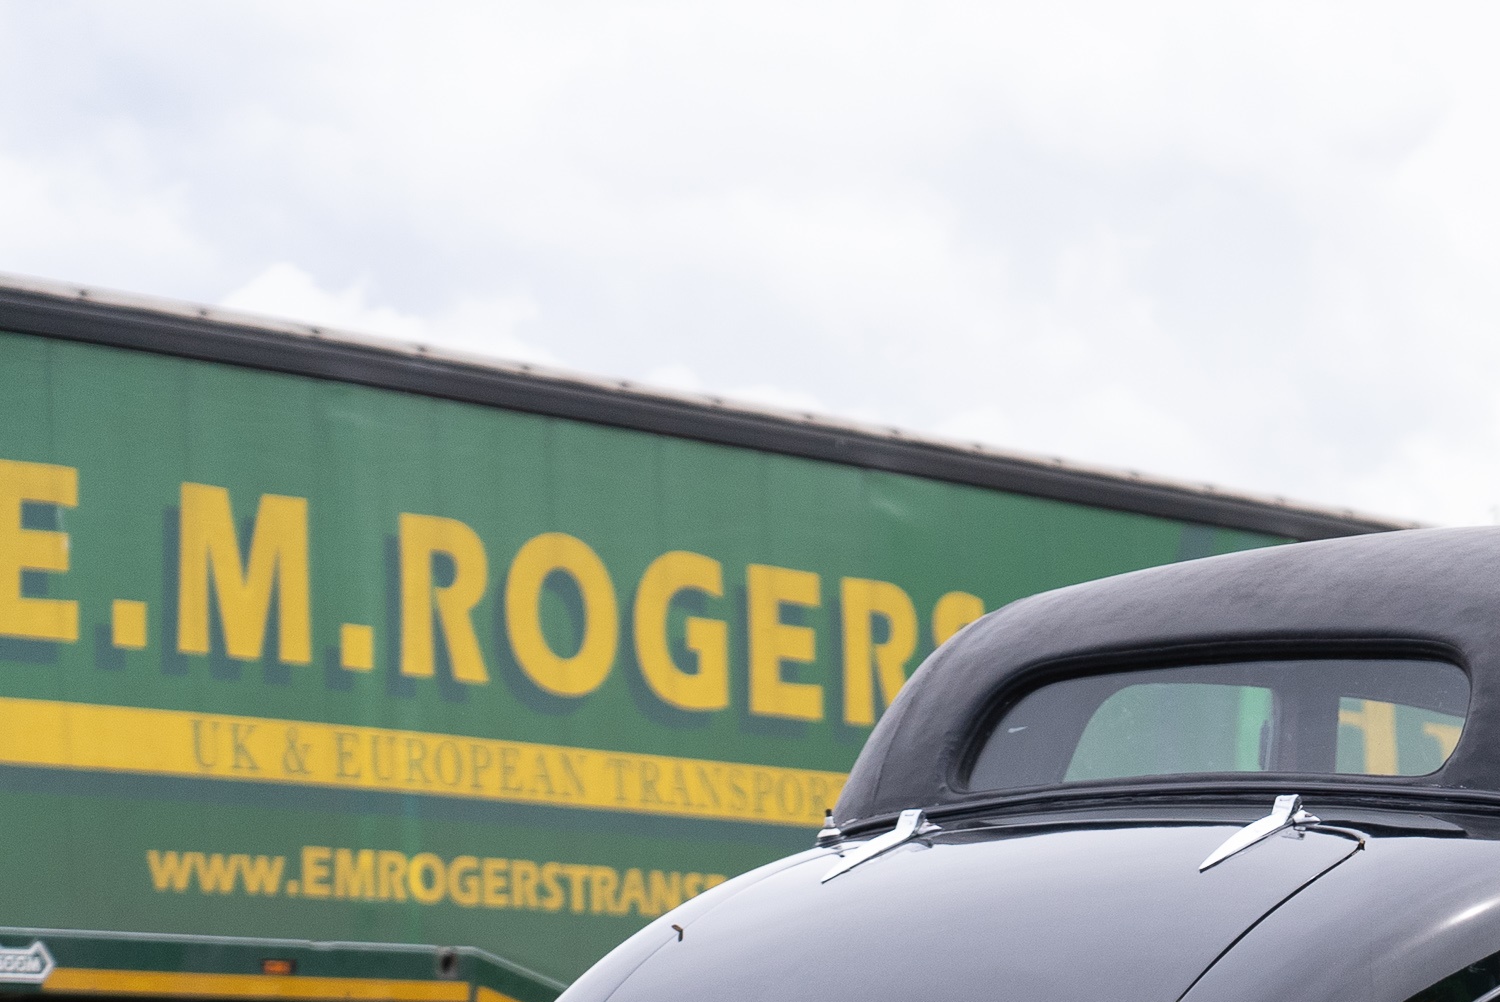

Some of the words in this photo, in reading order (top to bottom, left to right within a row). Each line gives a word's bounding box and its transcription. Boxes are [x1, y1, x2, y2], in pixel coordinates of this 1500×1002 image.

[189, 717, 261, 772] UK
[281, 725, 313, 776] &
[334, 731, 587, 799] EUROPEAN
[605, 756, 847, 819] TRANSPOR
